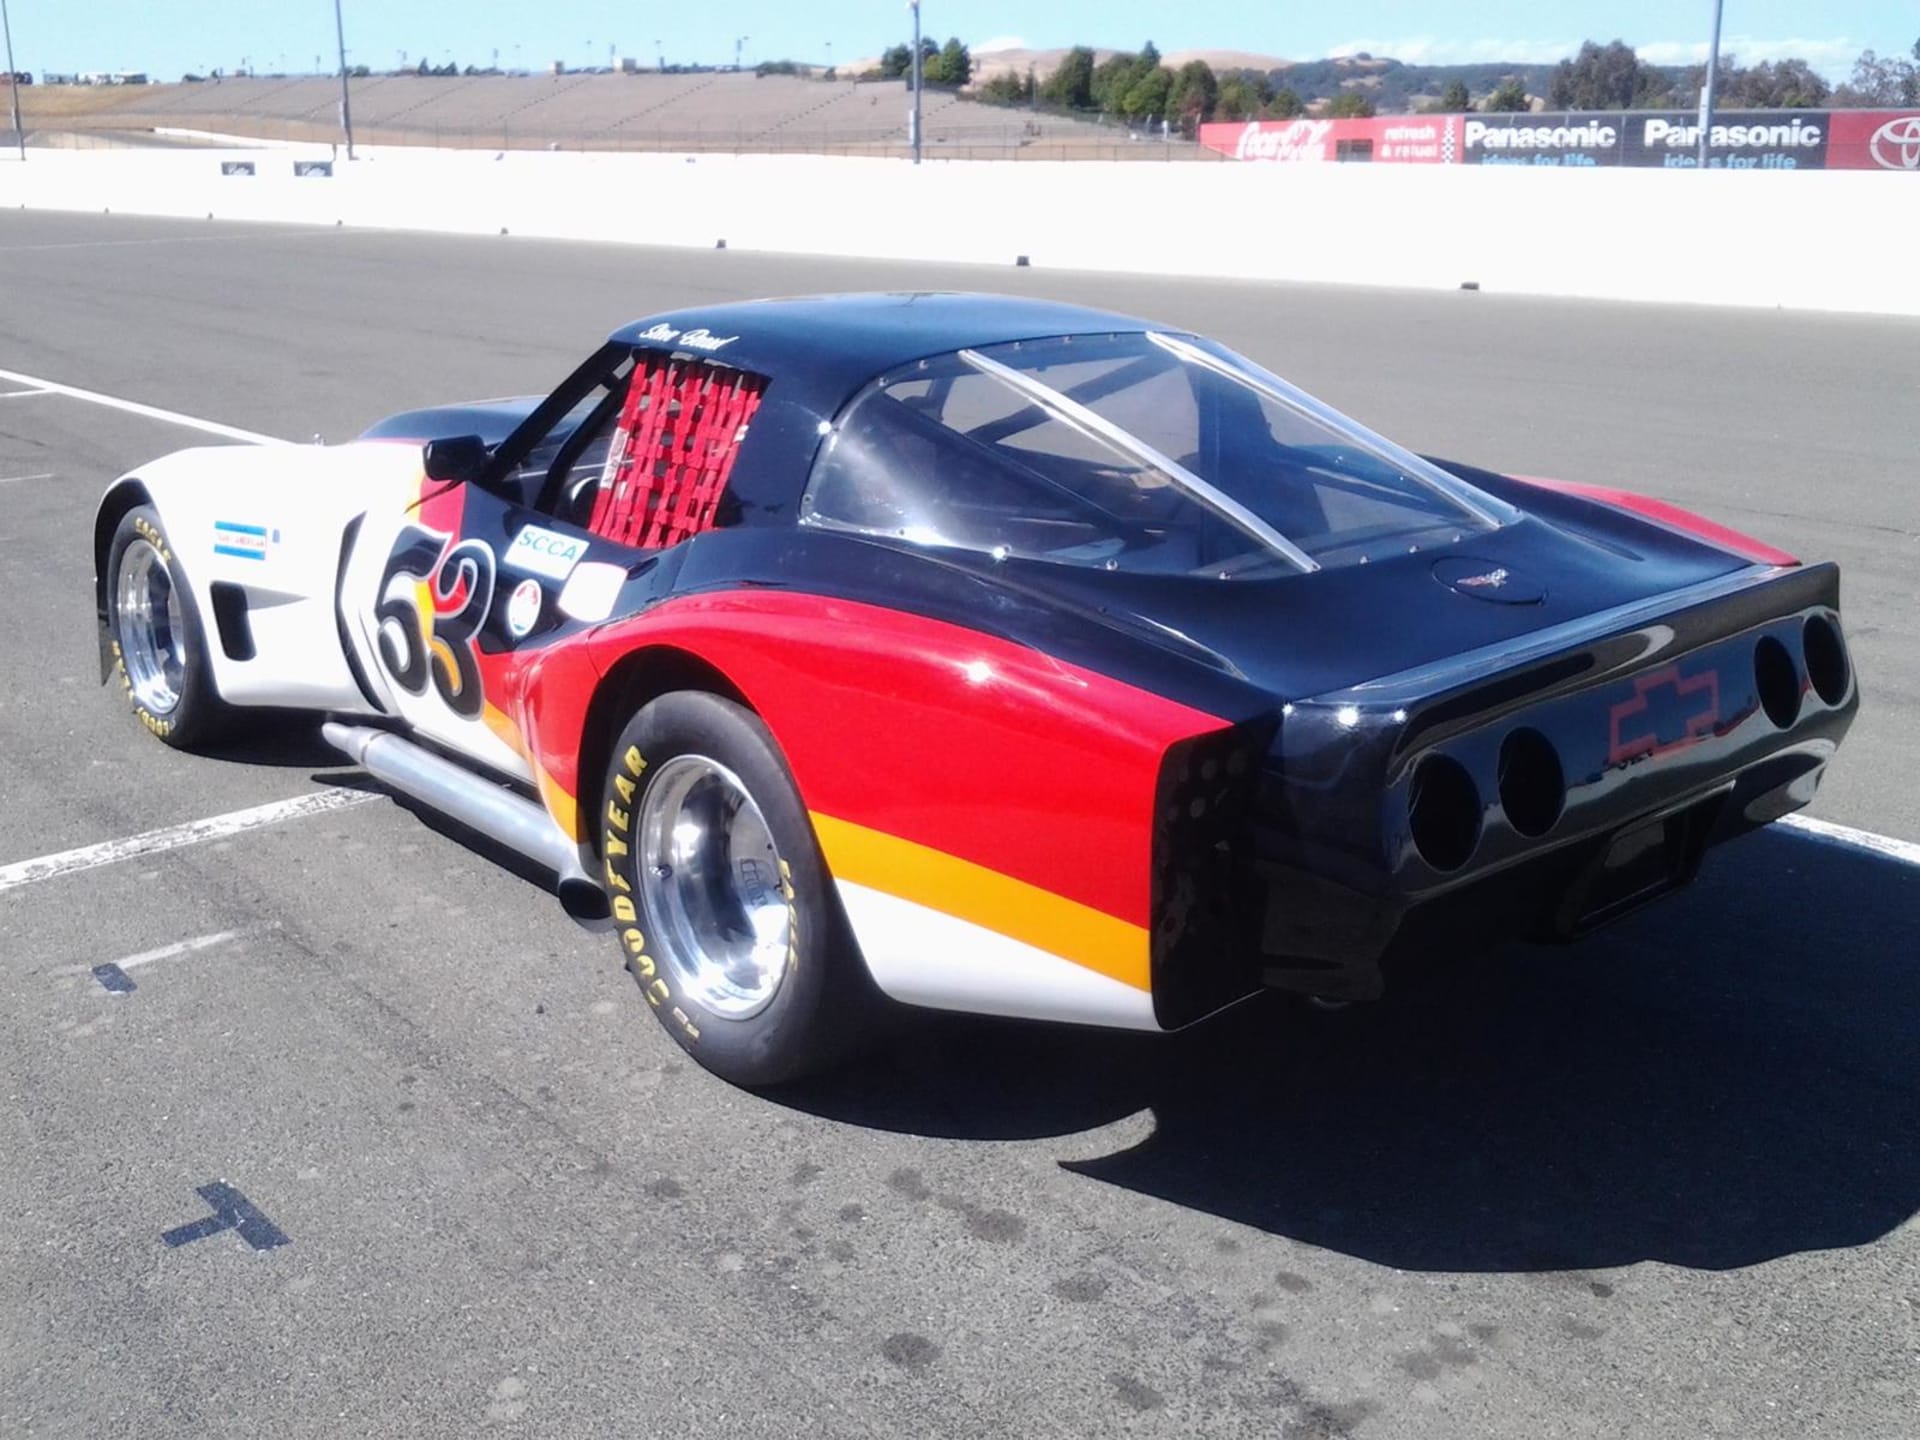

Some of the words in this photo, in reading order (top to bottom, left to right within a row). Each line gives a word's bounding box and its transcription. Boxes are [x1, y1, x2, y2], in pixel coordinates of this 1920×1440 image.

[1384, 126, 1436, 140] refresh
[1464, 120, 1616, 148] Panasonic
[1395, 144, 1437, 157] refuel
[1534, 154, 1560, 167] for
[1565, 154, 1596, 167] life
[1726, 153, 1757, 169] for
[1763, 153, 1796, 169] life
[519, 531, 577, 560] SCCA
[375, 525, 497, 721] 63
